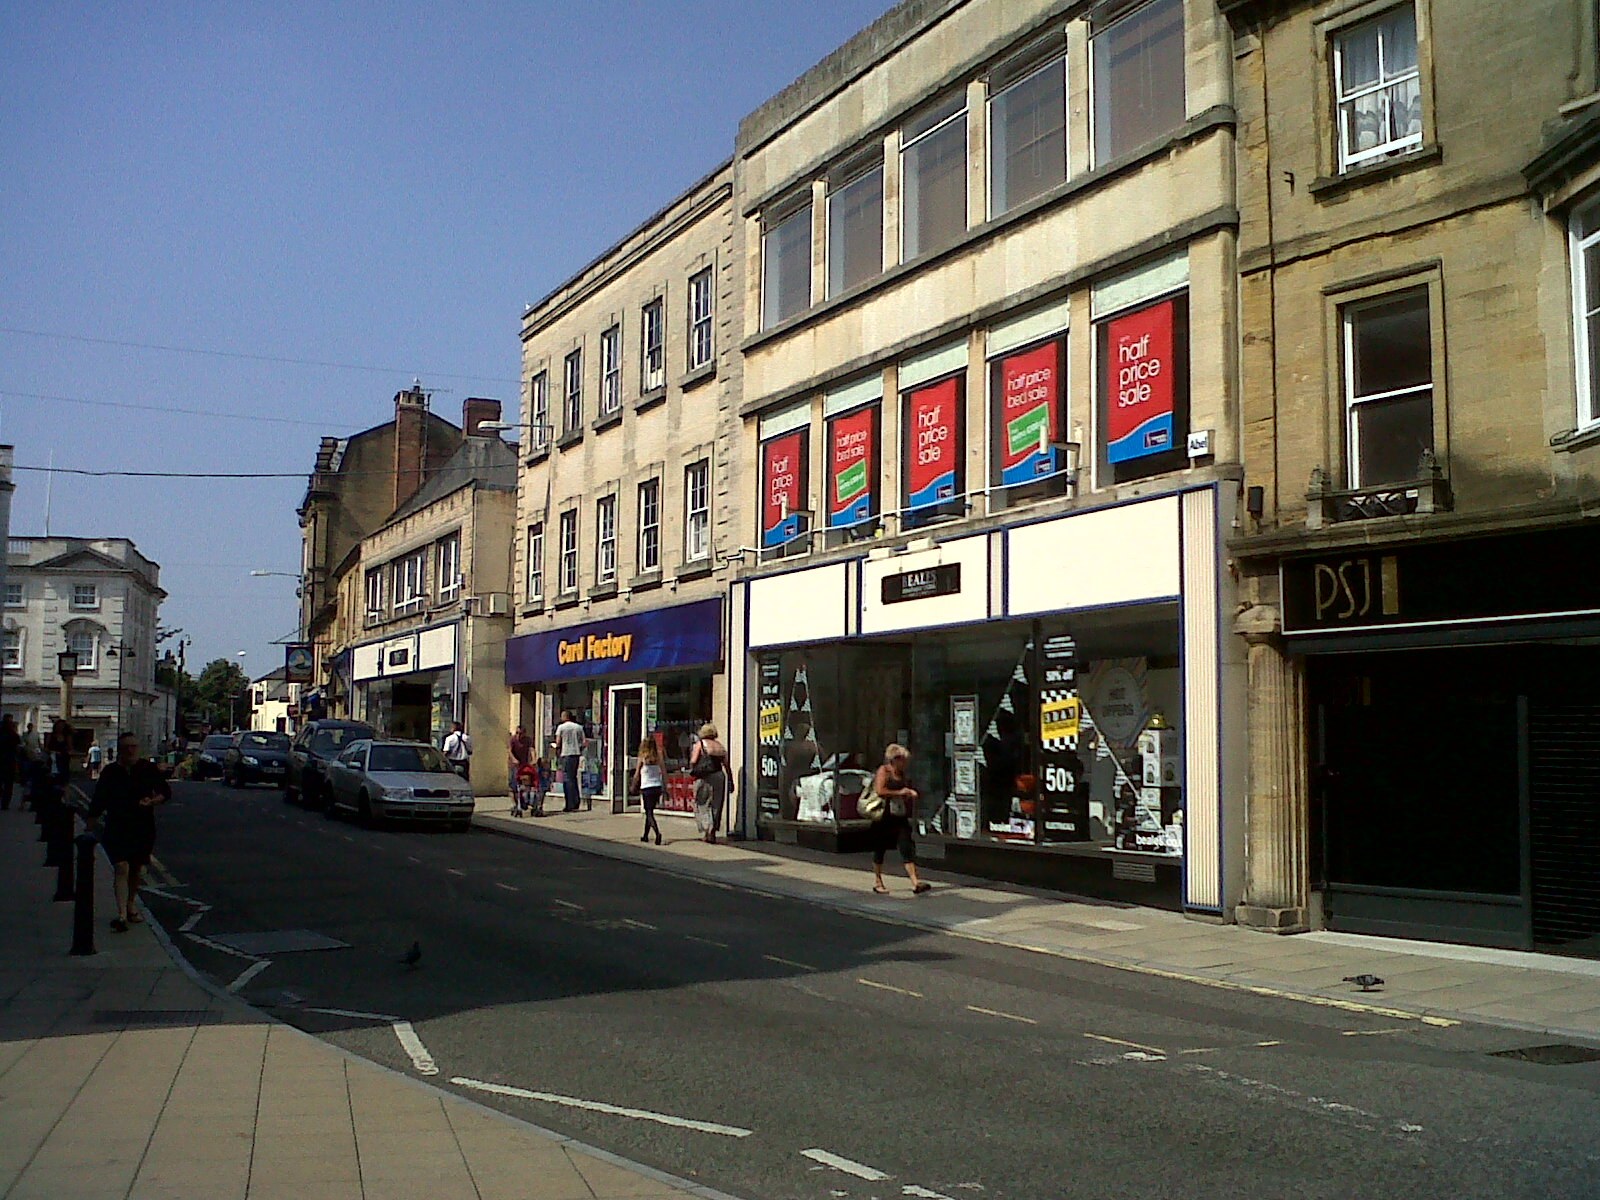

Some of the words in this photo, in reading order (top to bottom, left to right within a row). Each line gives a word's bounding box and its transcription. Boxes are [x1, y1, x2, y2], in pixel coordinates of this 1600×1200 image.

[1118, 334, 1150, 363] half
[1008, 373, 1026, 391] half
[1026, 368, 1051, 389] price
[1119, 358, 1161, 391] price
[1008, 392, 1027, 408] bed
[1028, 385, 1048, 402] sale
[1117, 381, 1152, 408] sale
[918, 405, 941, 428] half
[836, 433, 850, 448] half
[850, 430, 867, 446] price
[919, 425, 948, 449] price
[771, 456, 788, 473] half
[836, 448, 850, 462] bed
[850, 445, 865, 458] sale
[918, 444, 941, 465] sale
[771, 472, 793, 492] price
[771, 490, 788, 506] sale
[902, 570, 937, 588] BEALES
[1314, 559, 1370, 620] PSJ
[558, 637, 585, 666] Card
[586, 632, 633, 662] Factory
